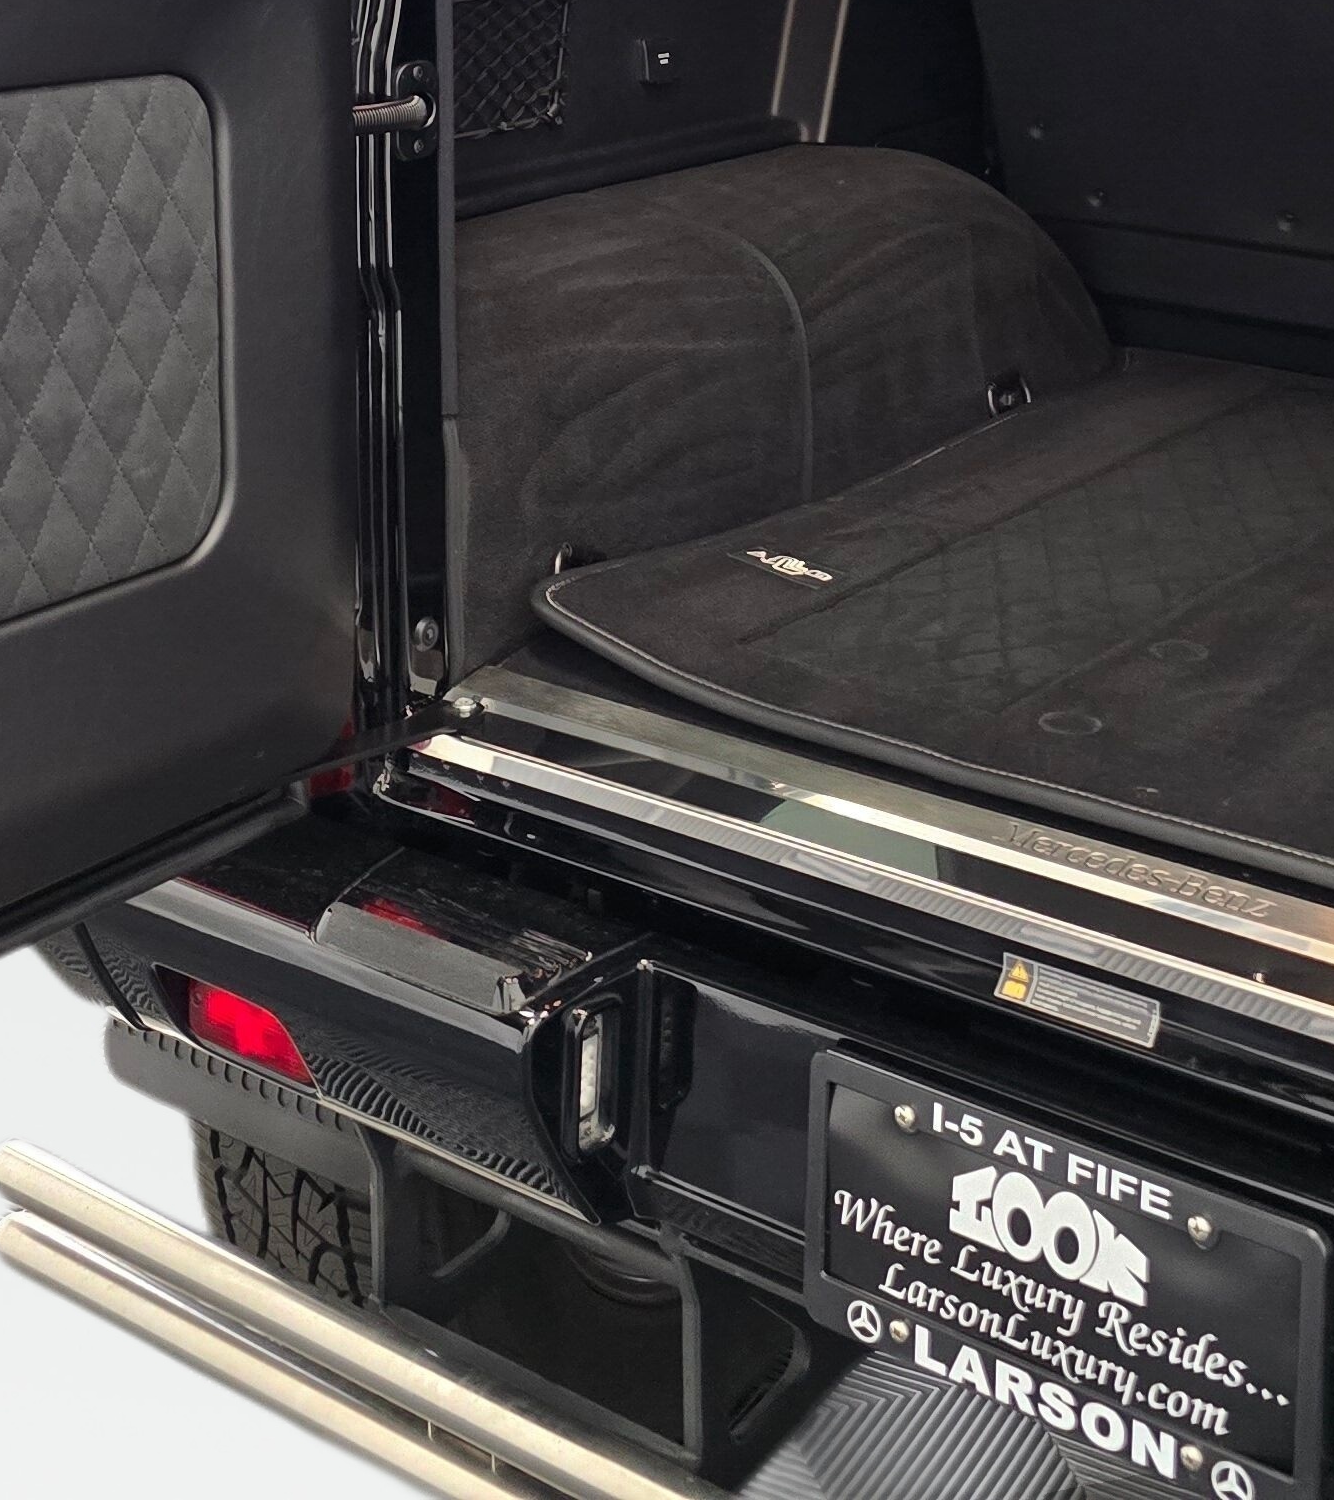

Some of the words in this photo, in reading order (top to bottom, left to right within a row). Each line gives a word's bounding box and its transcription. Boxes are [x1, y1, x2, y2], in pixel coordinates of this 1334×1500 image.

[992, 821, 1277, 918] Mercedes-Benz
[932, 1102, 984, 1146] I-5
[992, 1129, 1054, 1172] AT
[1067, 1152, 1174, 1221] FIFE
[834, 1189, 943, 1264] Where
[950, 1244, 1086, 1338] Luxury
[1094, 1300, 1291, 1407] Resides...
[878, 1262, 1231, 1436] LarsonLuxury.com
[913, 1323, 1178, 1480] LARSON
